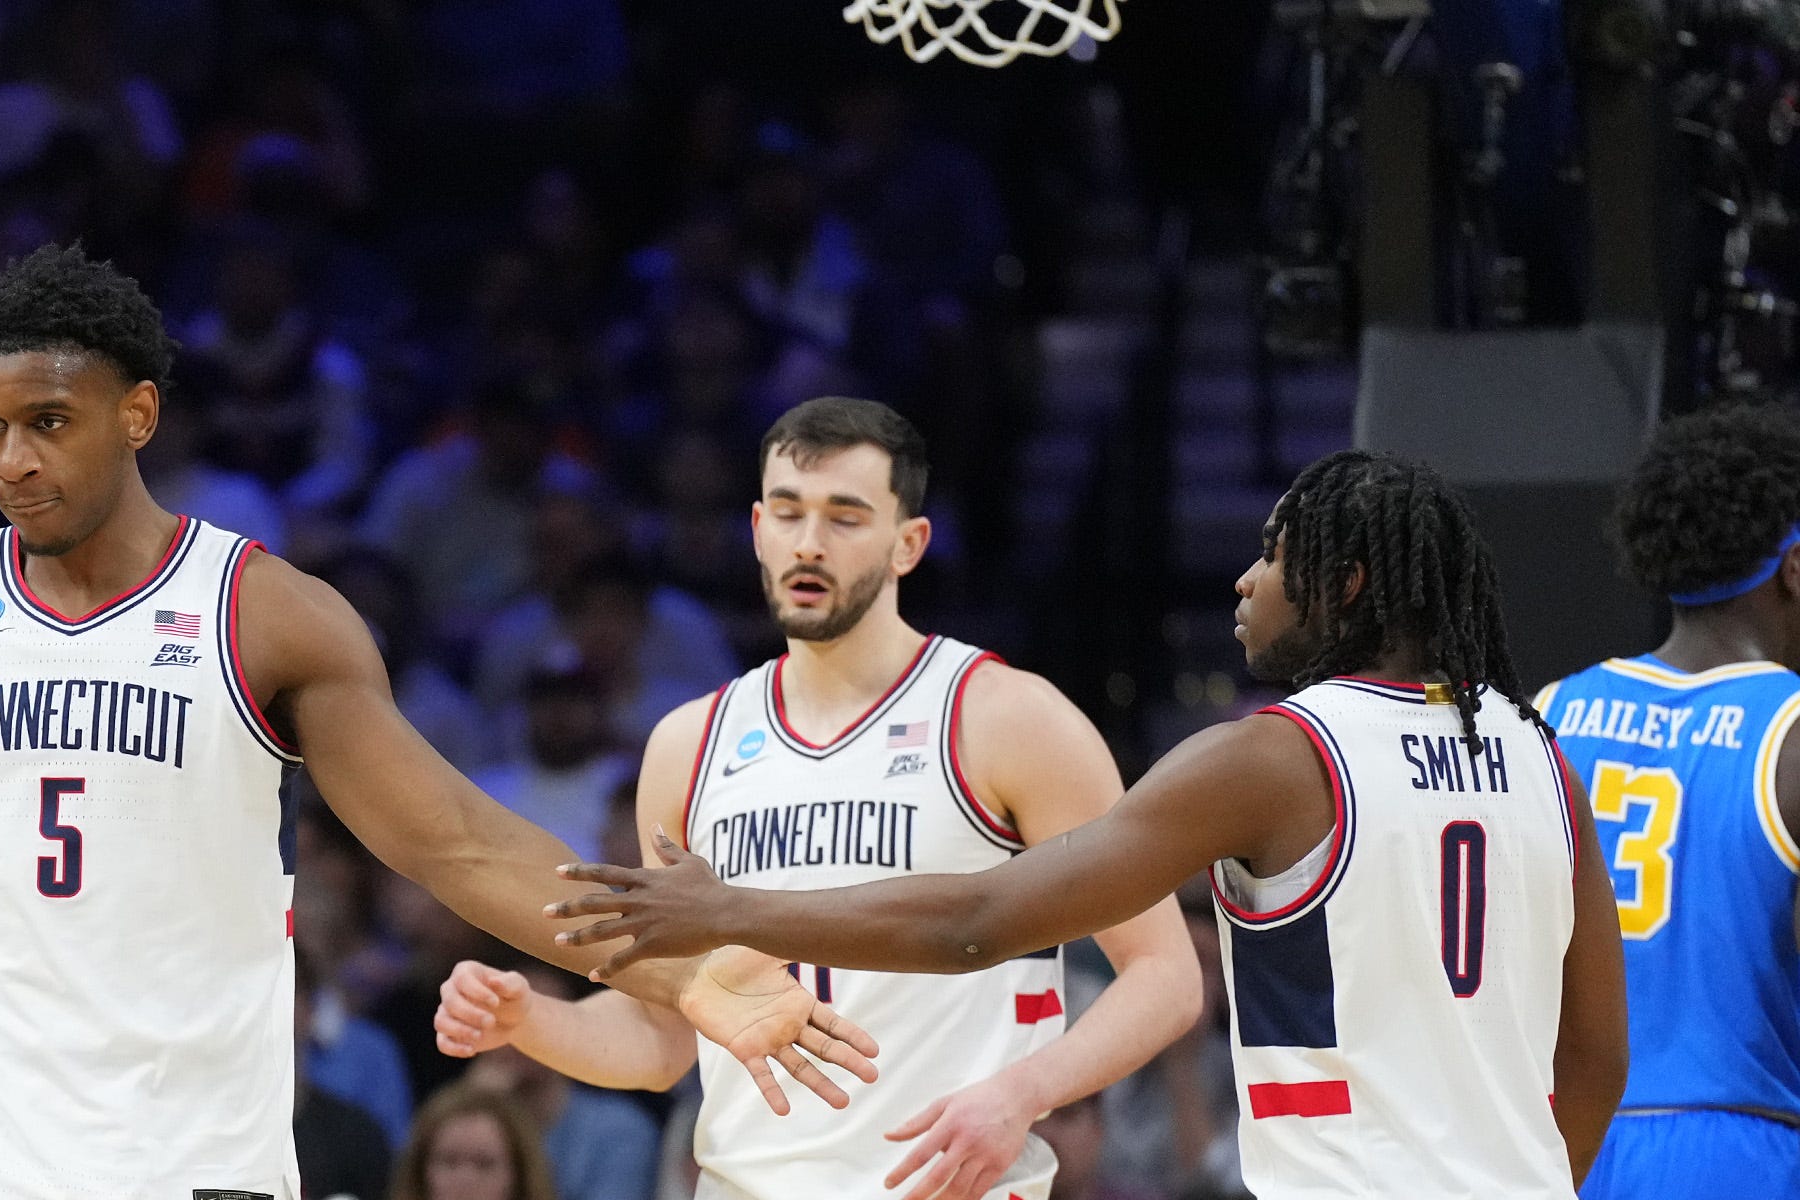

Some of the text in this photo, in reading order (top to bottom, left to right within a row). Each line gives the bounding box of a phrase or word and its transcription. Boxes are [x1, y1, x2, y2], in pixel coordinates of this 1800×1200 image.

[153, 654, 203, 664] EAST
[160, 643, 195, 654] BIG
[1556, 697, 1694, 750] DAILEY
[1401, 734, 1509, 793] SMITH
[37, 777, 86, 898] 5
[713, 800, 918, 881] CONNECTICUT
[1591, 759, 1683, 941] 3
[1441, 820, 1486, 998] 0
